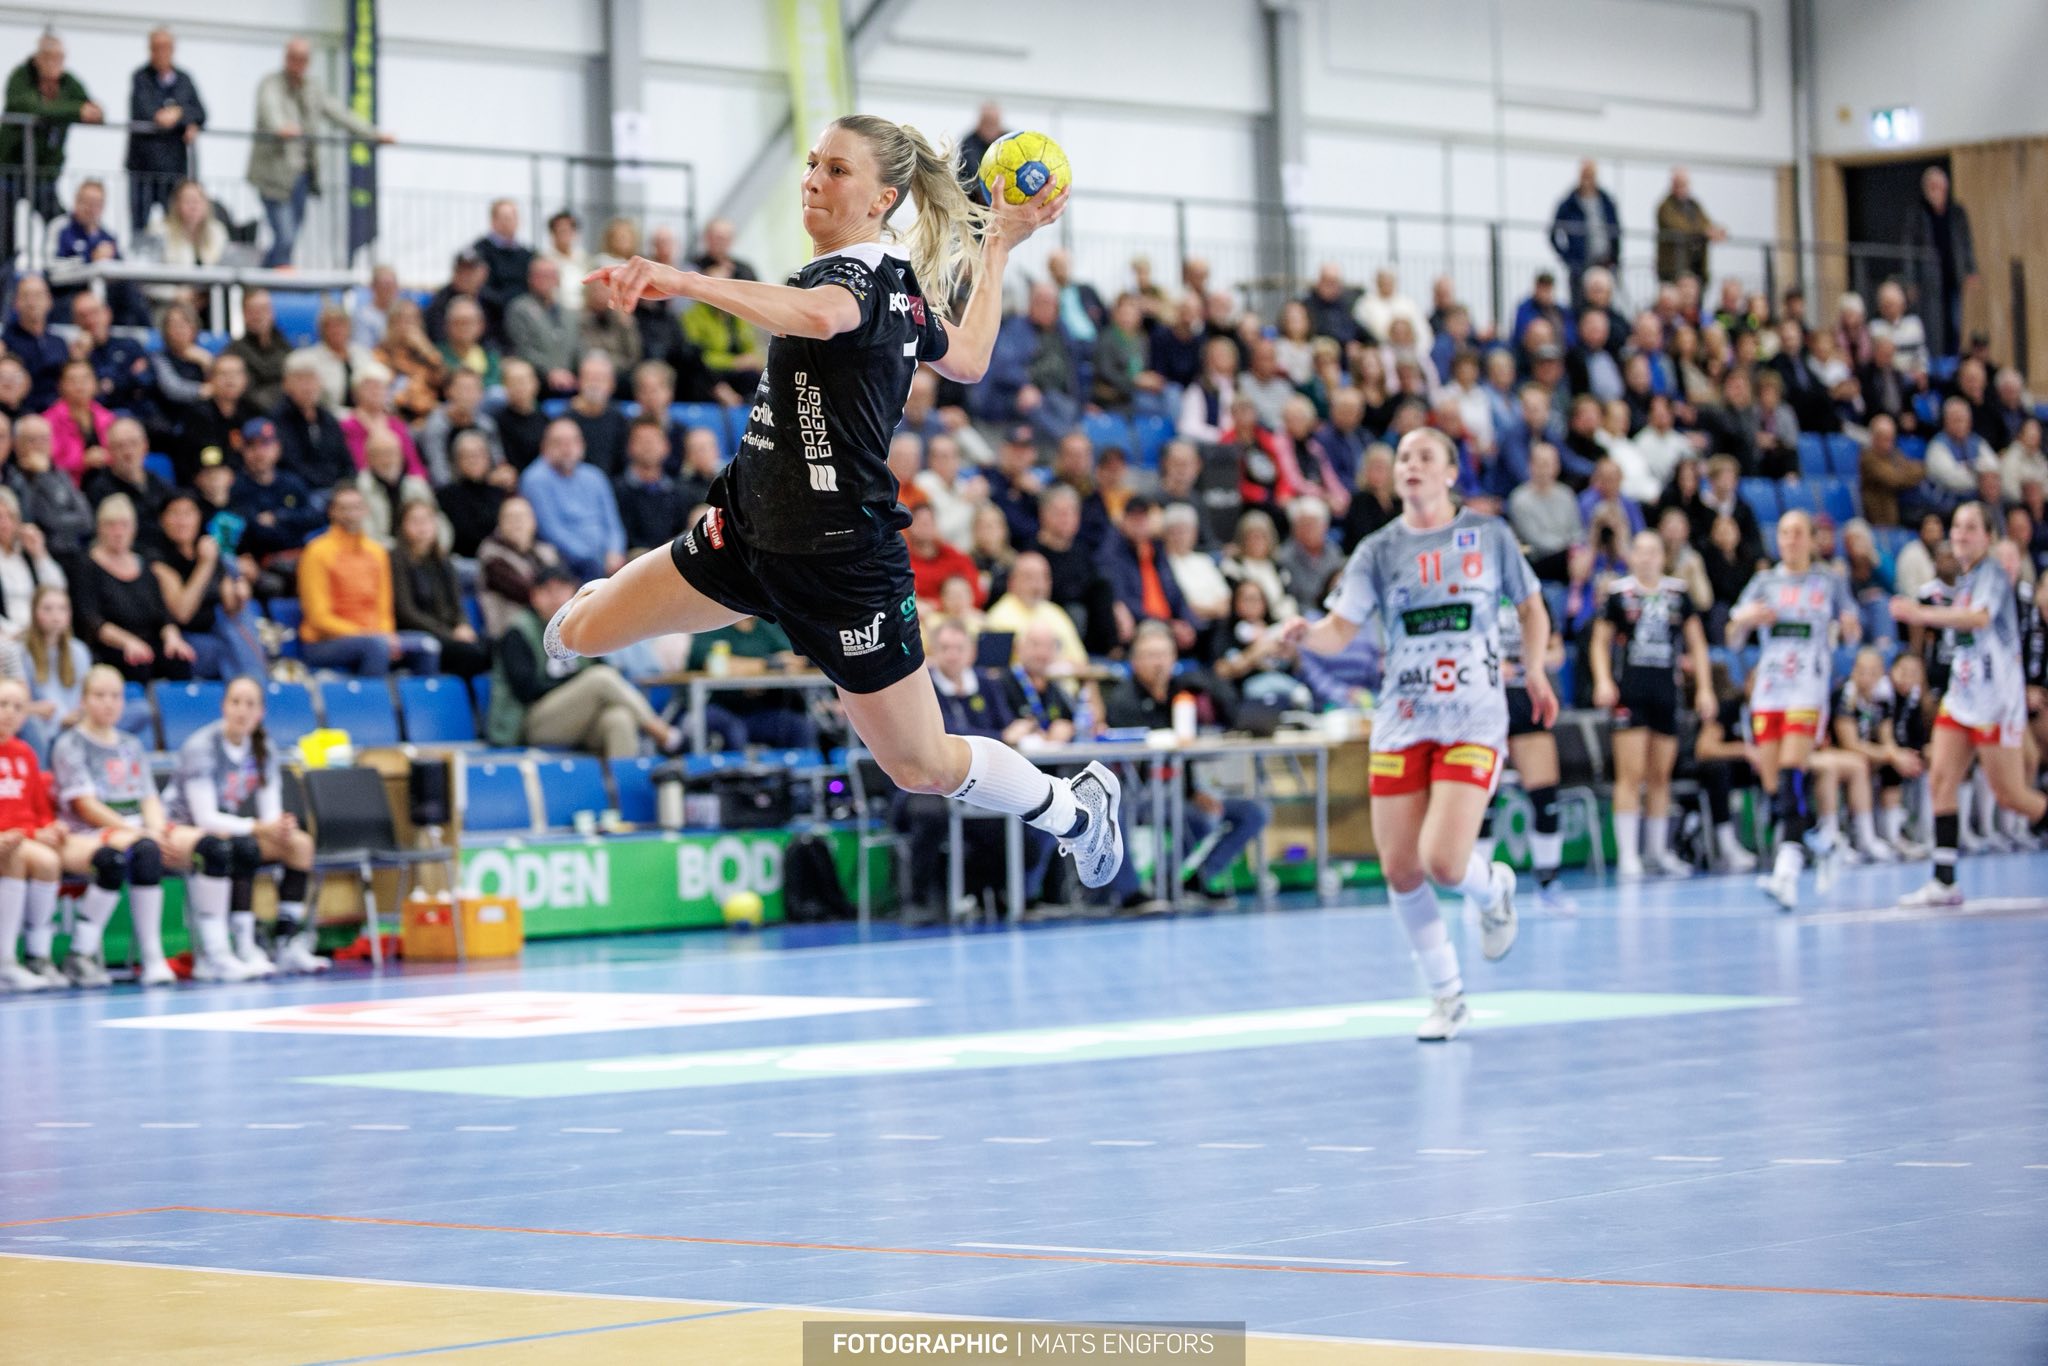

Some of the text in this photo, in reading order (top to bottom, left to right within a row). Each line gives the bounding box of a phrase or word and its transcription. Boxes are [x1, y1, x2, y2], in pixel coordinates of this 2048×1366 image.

[794, 371, 818, 460] BODENS
[808, 385, 833, 459] ENERGI
[1417, 551, 1442, 585] 11
[464, 850, 609, 909] ODEN
[677, 837, 781, 904] BOD
